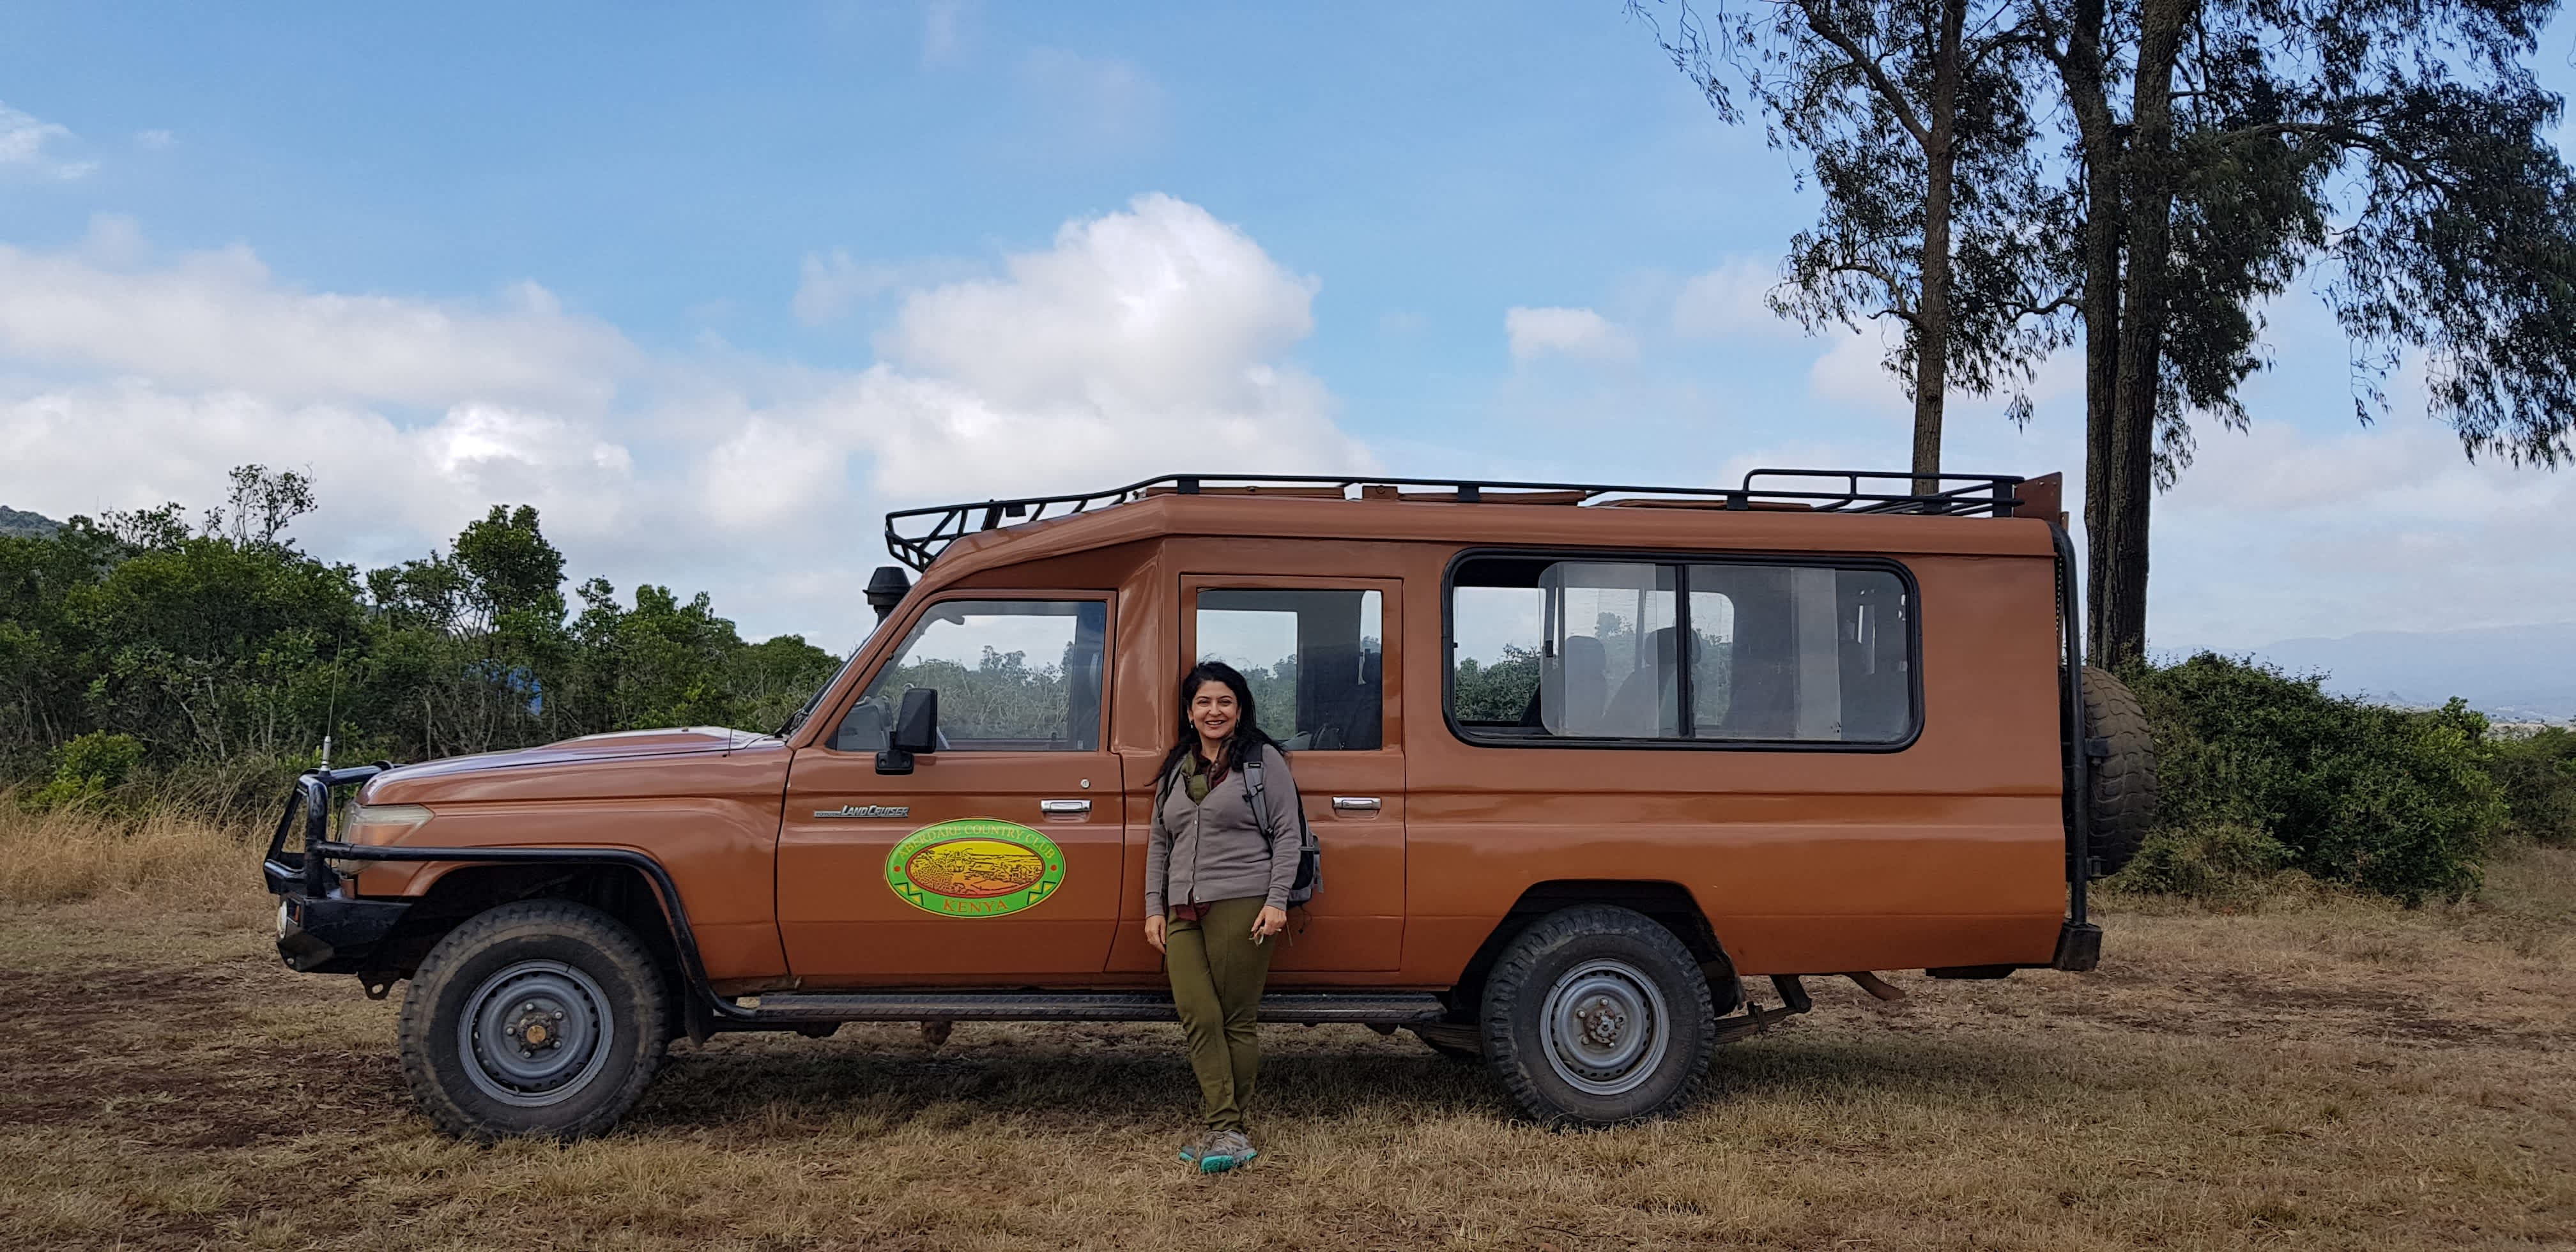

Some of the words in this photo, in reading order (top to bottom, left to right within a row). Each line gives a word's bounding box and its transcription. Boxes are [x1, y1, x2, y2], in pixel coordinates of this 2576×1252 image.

[898, 825, 961, 859] ABERDARE
[965, 825, 1024, 839] COUNTRY
[1025, 833, 1055, 859] CLUB
[944, 899, 1008, 913] KENYA
